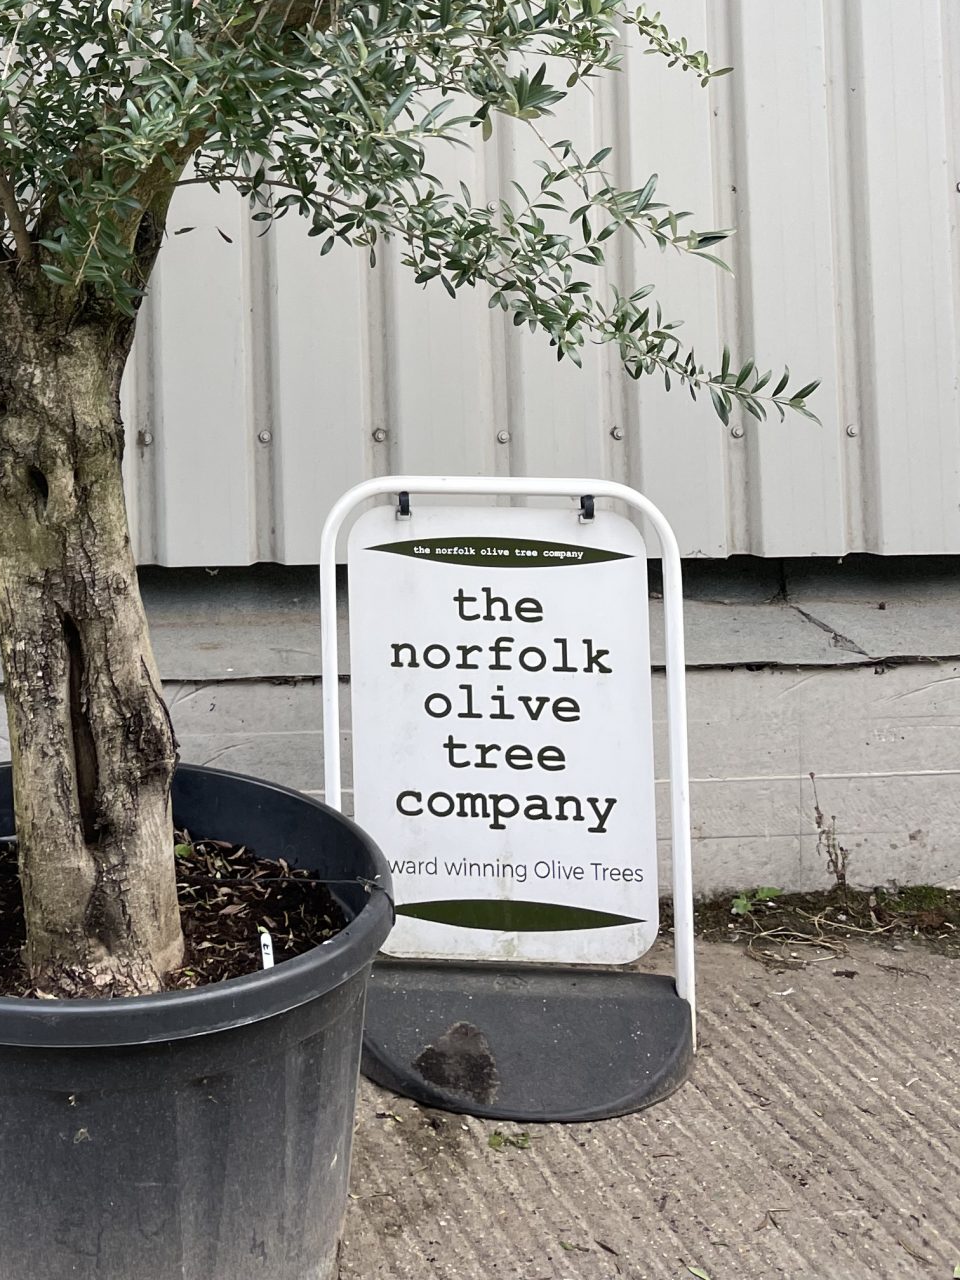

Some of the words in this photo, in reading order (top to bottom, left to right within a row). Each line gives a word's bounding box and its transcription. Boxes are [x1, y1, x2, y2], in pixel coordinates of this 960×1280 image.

[413, 545, 431, 555] the
[435, 546, 476, 556] norfolk
[480, 547, 510, 557] olive
[515, 548, 538, 558] tree
[542, 549, 584, 560] company
[453, 587, 544, 623] the
[390, 636, 613, 674] norfolk
[424, 684, 581, 723] olive
[443, 734, 566, 772] tree
[395, 790, 617, 833] company
[387, 856, 438, 876] ward
[444, 857, 527, 883] winning
[533, 859, 585, 882] Olive
[590, 862, 644, 884] Trees
